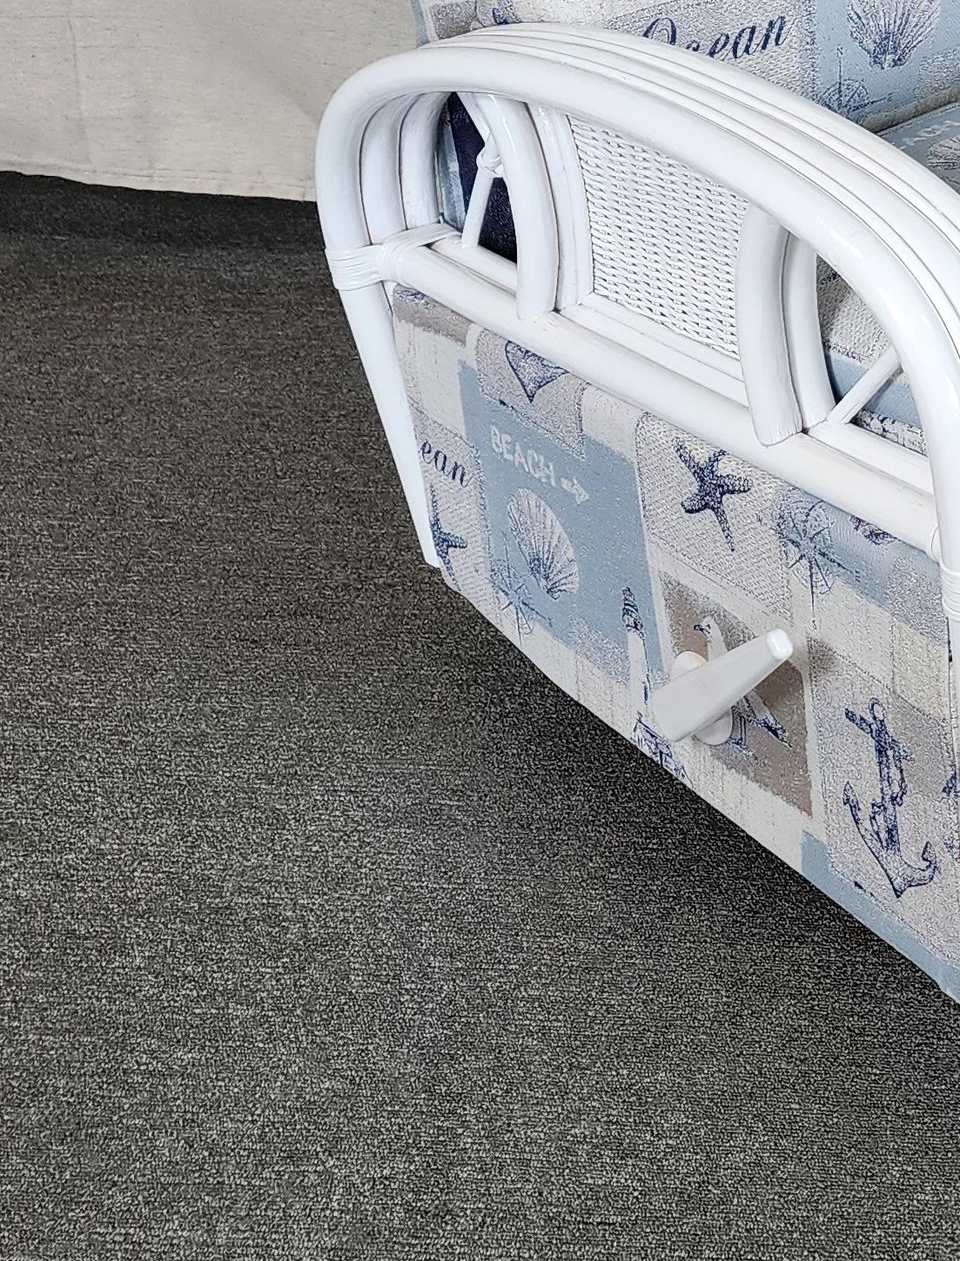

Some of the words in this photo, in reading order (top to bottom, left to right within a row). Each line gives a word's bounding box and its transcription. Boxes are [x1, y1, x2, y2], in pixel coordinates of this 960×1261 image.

[643, 16, 796, 61] ean
[418, 440, 476, 488] ean
[490, 424, 556, 487] BEACH
